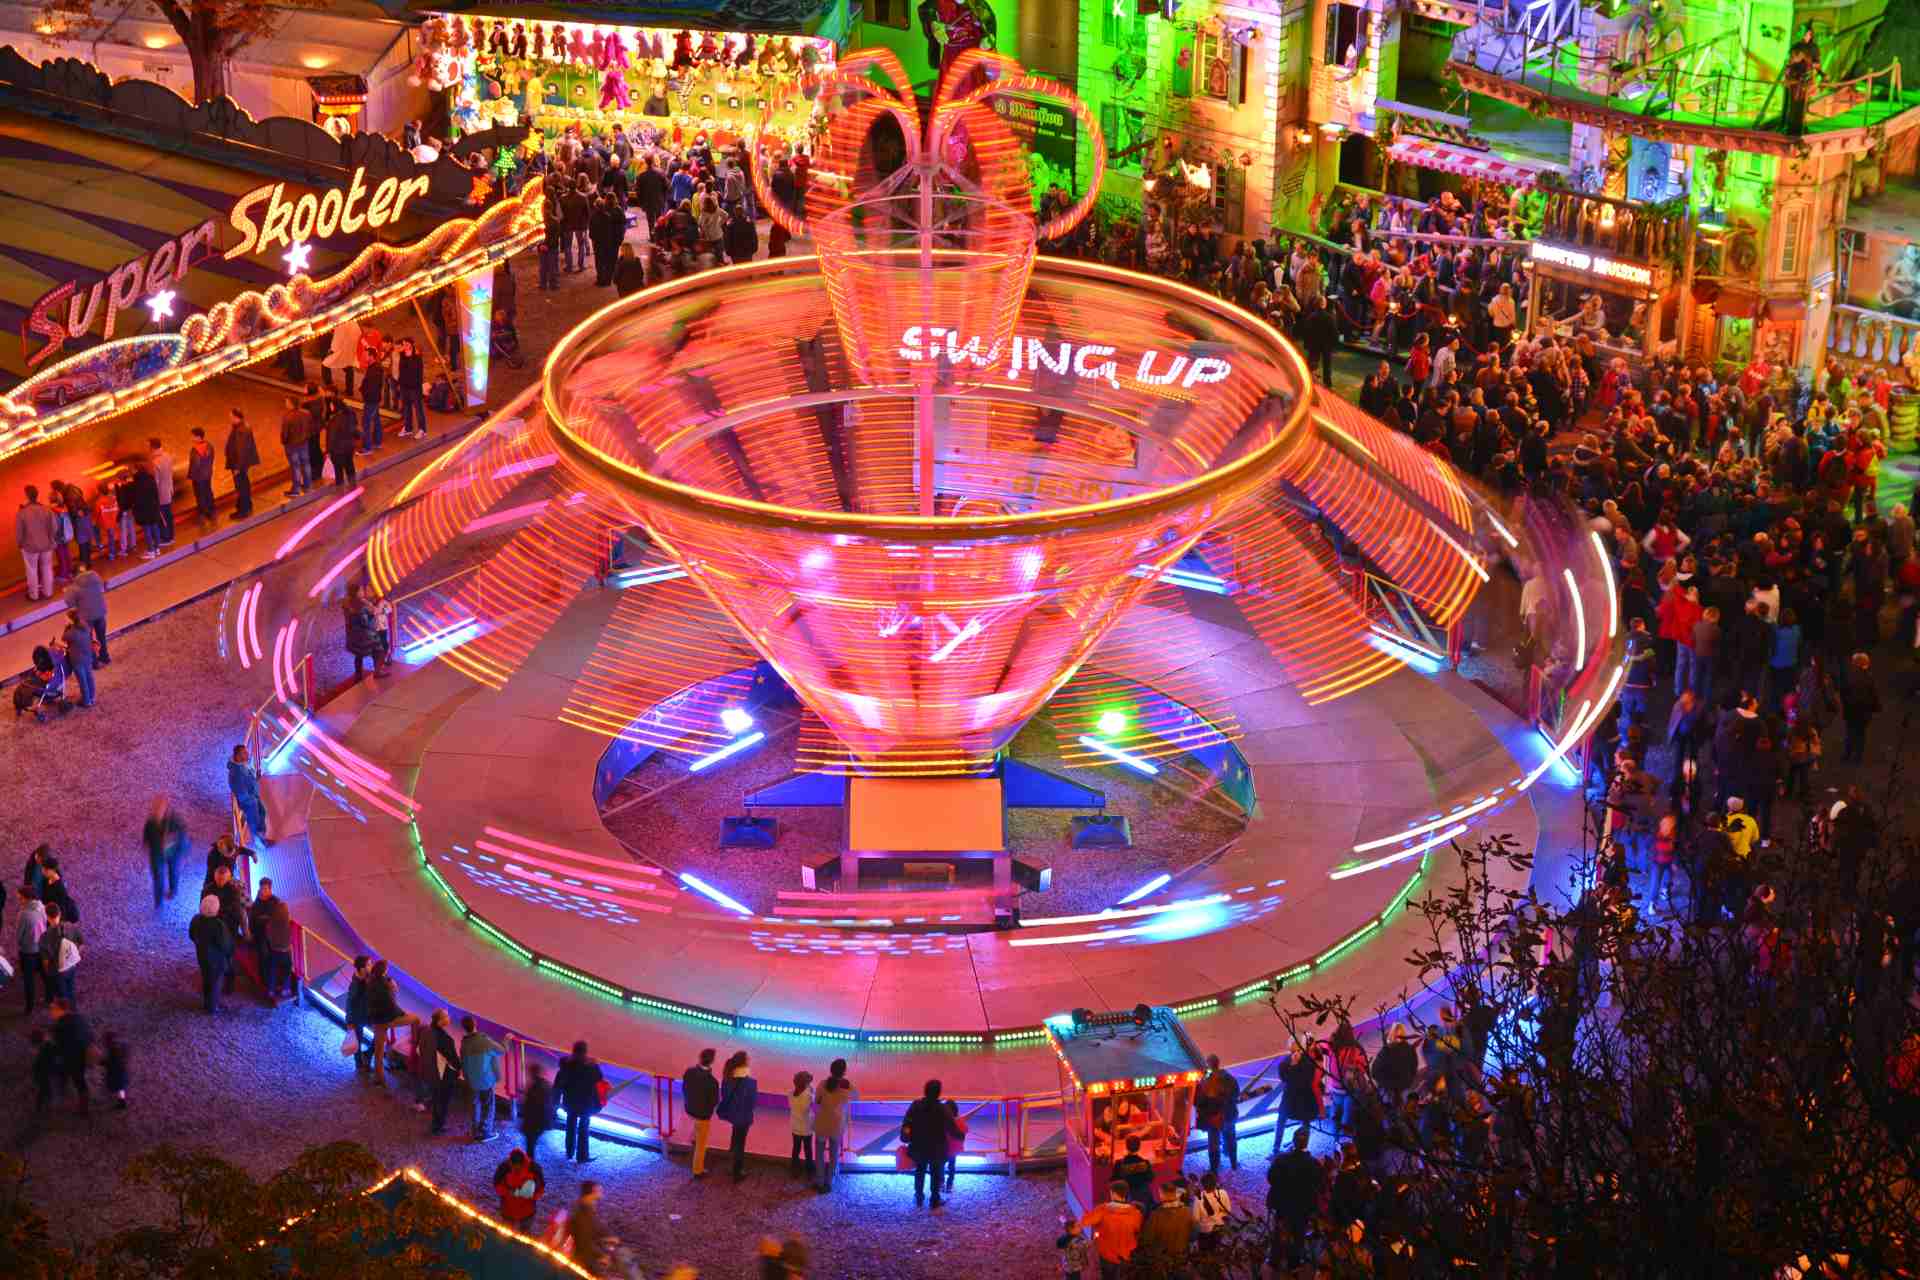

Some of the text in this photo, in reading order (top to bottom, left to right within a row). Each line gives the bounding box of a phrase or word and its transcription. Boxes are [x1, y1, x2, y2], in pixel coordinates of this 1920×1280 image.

[26, 167, 430, 367] Super Skooter
[899, 326, 1231, 389] SWING UP
